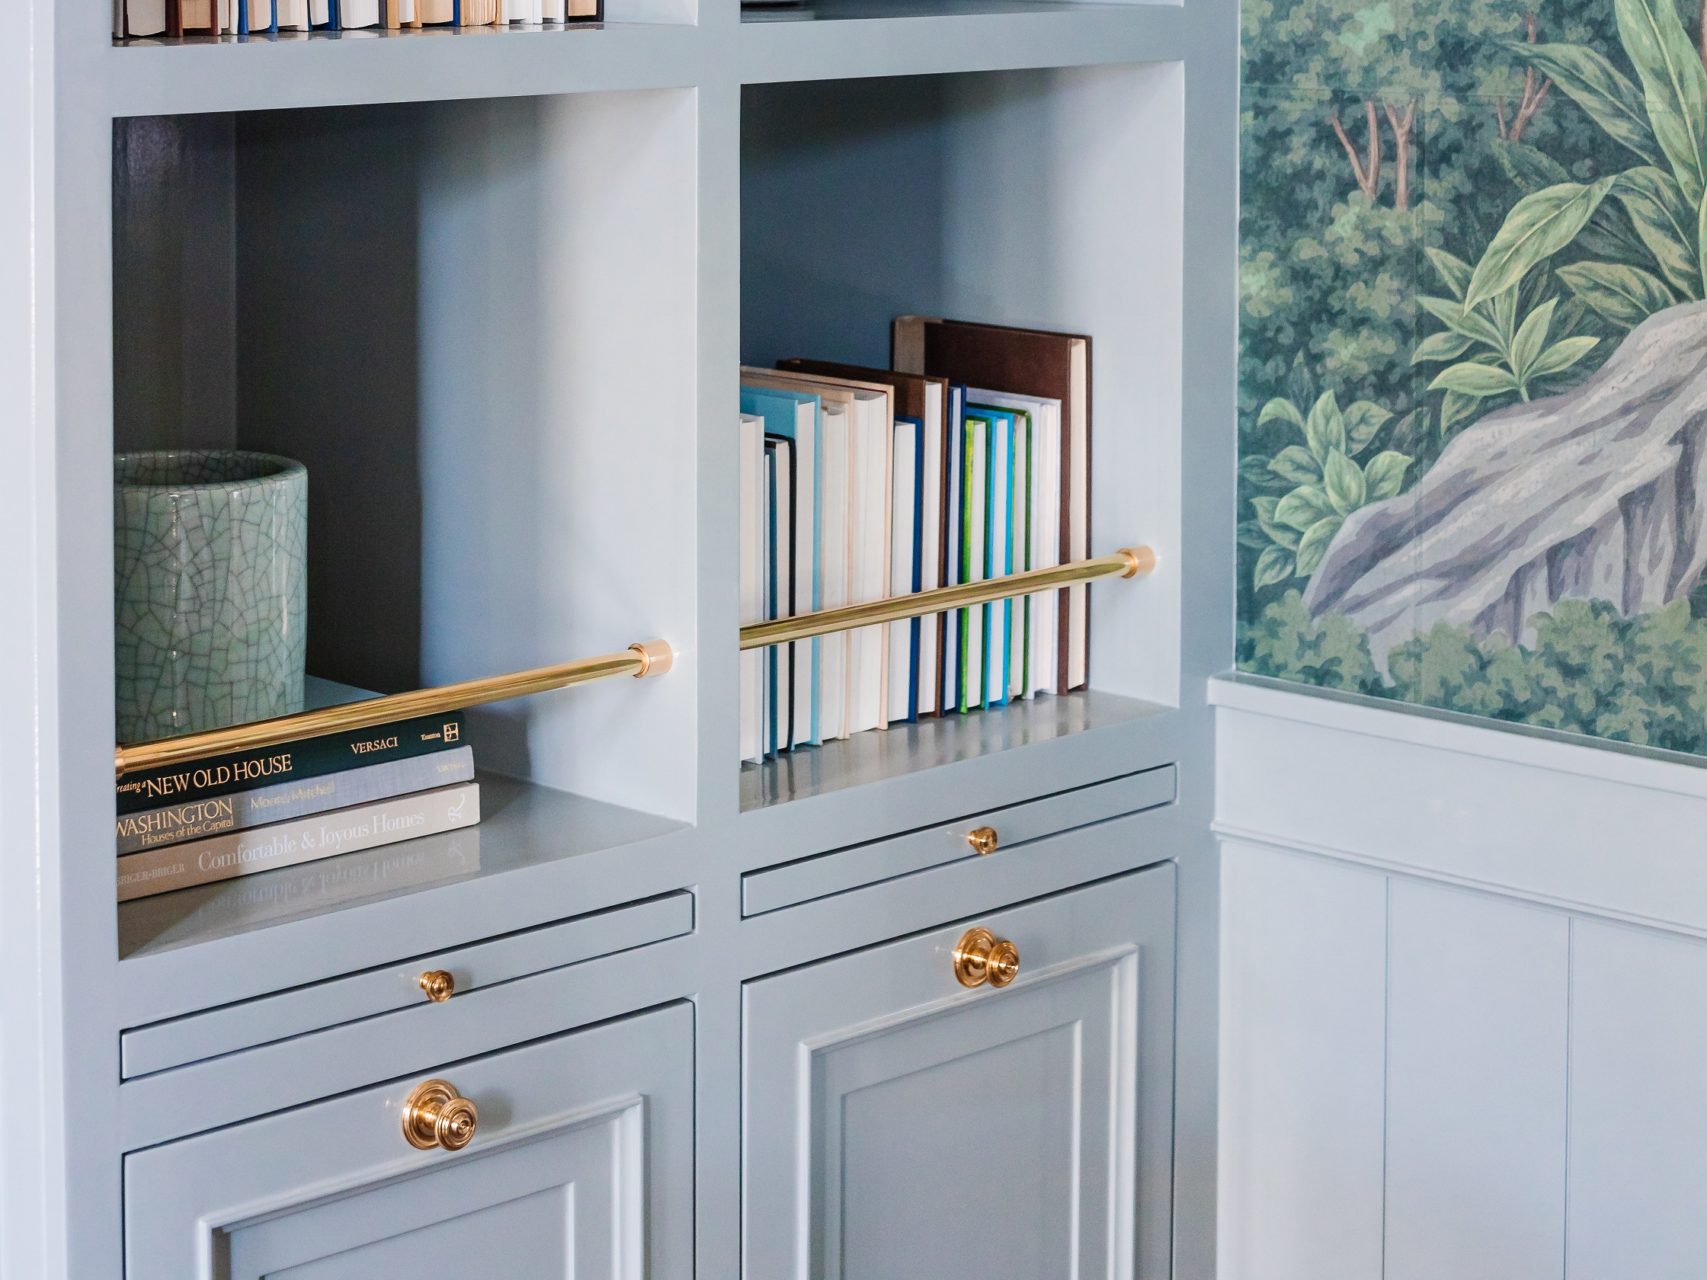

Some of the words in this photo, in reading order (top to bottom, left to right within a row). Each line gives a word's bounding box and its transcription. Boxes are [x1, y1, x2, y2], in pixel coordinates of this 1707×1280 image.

[350, 736, 399, 754] VERSACI
[147, 772, 191, 797] NEW
[193, 765, 231, 789] OLD
[233, 754, 293, 782] HOUSE
[141, 831, 175, 846] Houses
[175, 826, 186, 837] of
[186, 823, 202, 836] the
[202, 816, 234, 833] Capital
[198, 834, 297, 871] Comfortable
[300, 832, 317, 849] &
[318, 823, 370, 850] Joyous
[372, 811, 426, 835] Homes
